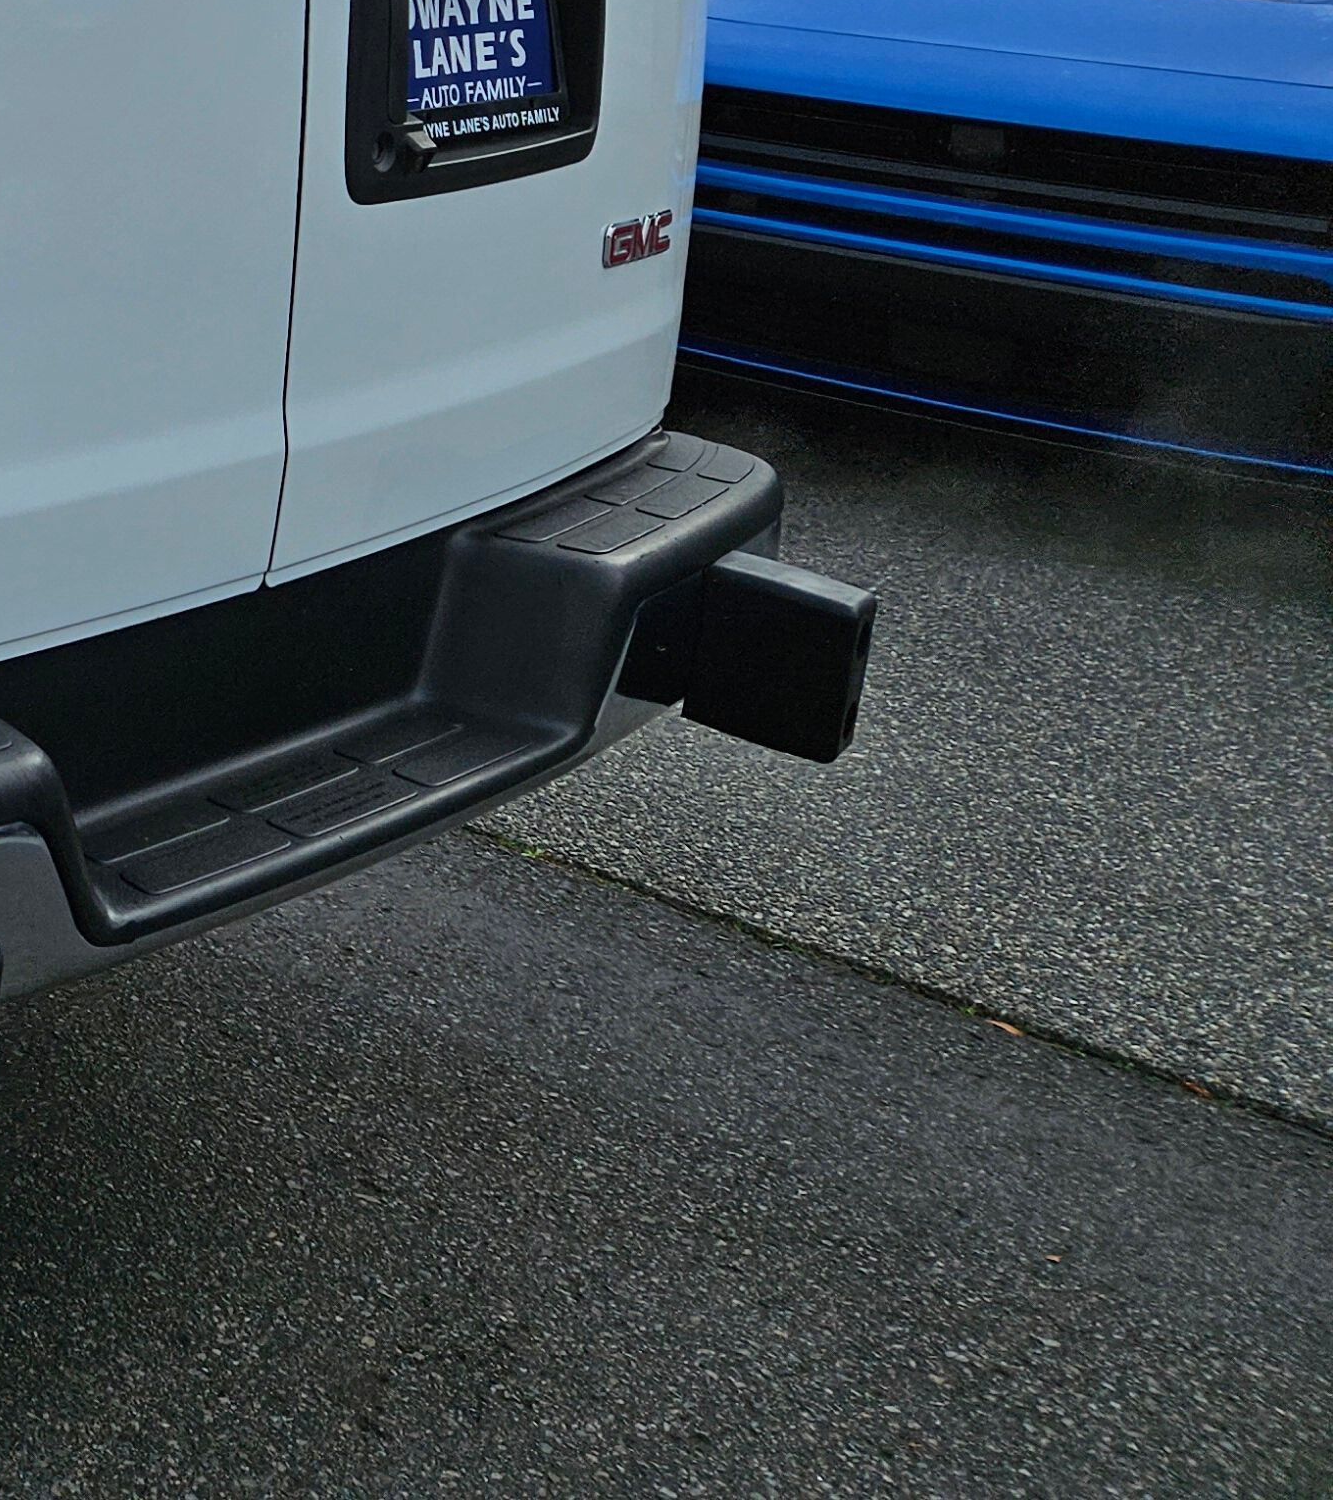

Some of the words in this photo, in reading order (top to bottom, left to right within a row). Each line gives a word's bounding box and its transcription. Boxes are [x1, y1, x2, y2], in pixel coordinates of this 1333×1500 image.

[413, 29, 527, 79] LANE'S
[421, 87, 460, 109] AUTO
[465, 76, 527, 103] FAMILY
[452, 116, 491, 136] LANE'S
[492, 112, 520, 131] AUTO
[521, 106, 561, 127] FAMILY
[602, 209, 673, 269] GMC
